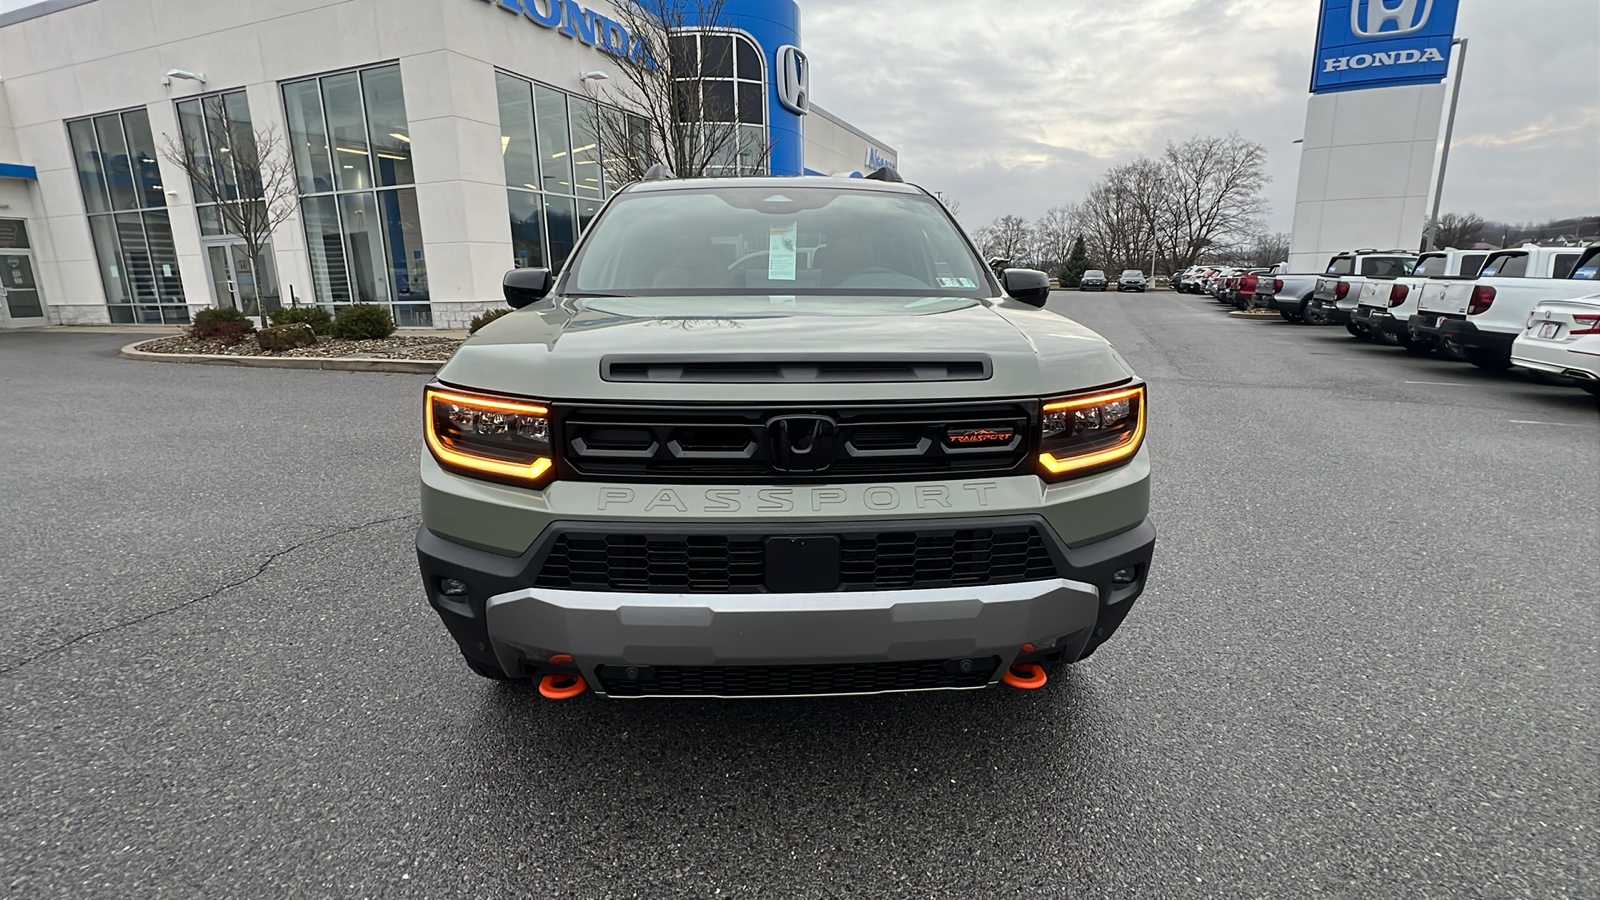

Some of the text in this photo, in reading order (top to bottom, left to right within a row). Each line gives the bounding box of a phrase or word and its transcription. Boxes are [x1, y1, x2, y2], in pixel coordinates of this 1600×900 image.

[477, 0, 659, 72] ONDA
[1323, 48, 1444, 72] HONDA
[949, 433, 1012, 443] TRAILSPORT
[597, 482, 998, 513] PASSPORT
